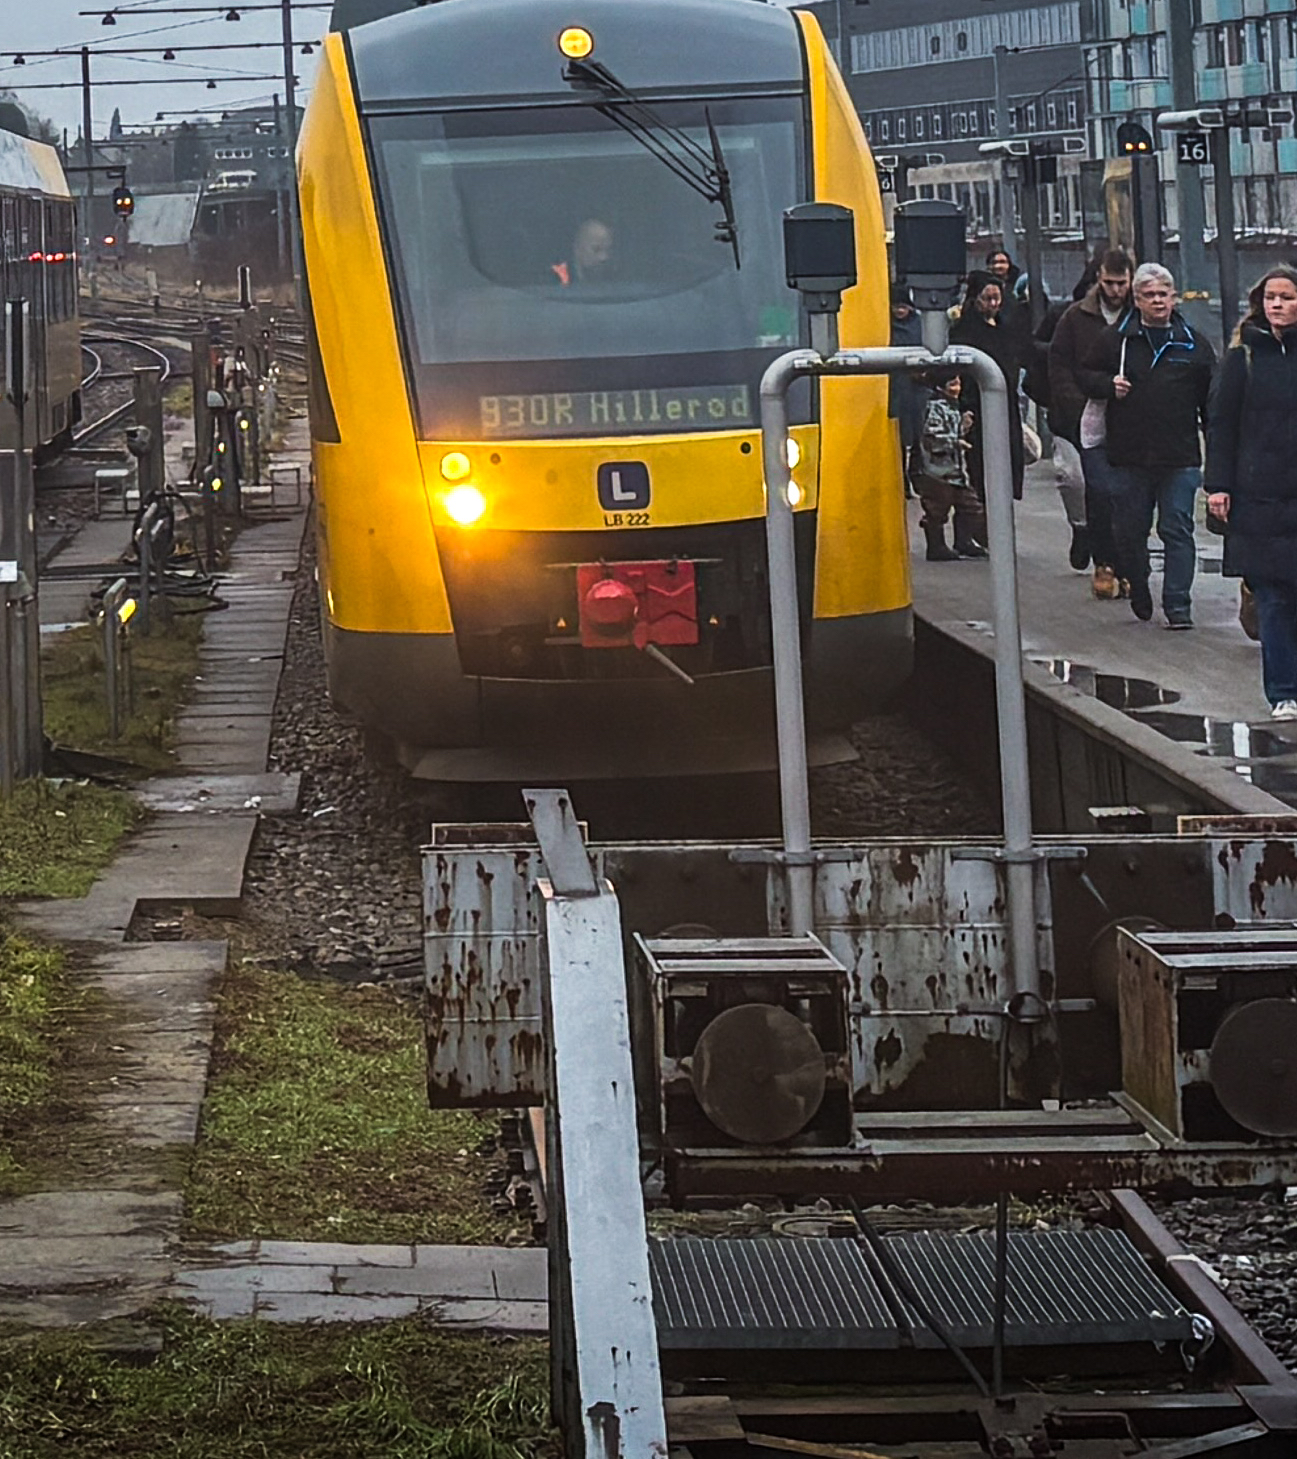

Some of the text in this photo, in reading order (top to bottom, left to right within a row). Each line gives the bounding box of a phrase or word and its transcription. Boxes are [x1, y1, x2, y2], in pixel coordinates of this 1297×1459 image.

[1180, 143, 1205, 160] 16
[481, 386, 749, 428] 930R Hillerød
[611, 471, 637, 501] L
[604, 512, 650, 527] LB 222
